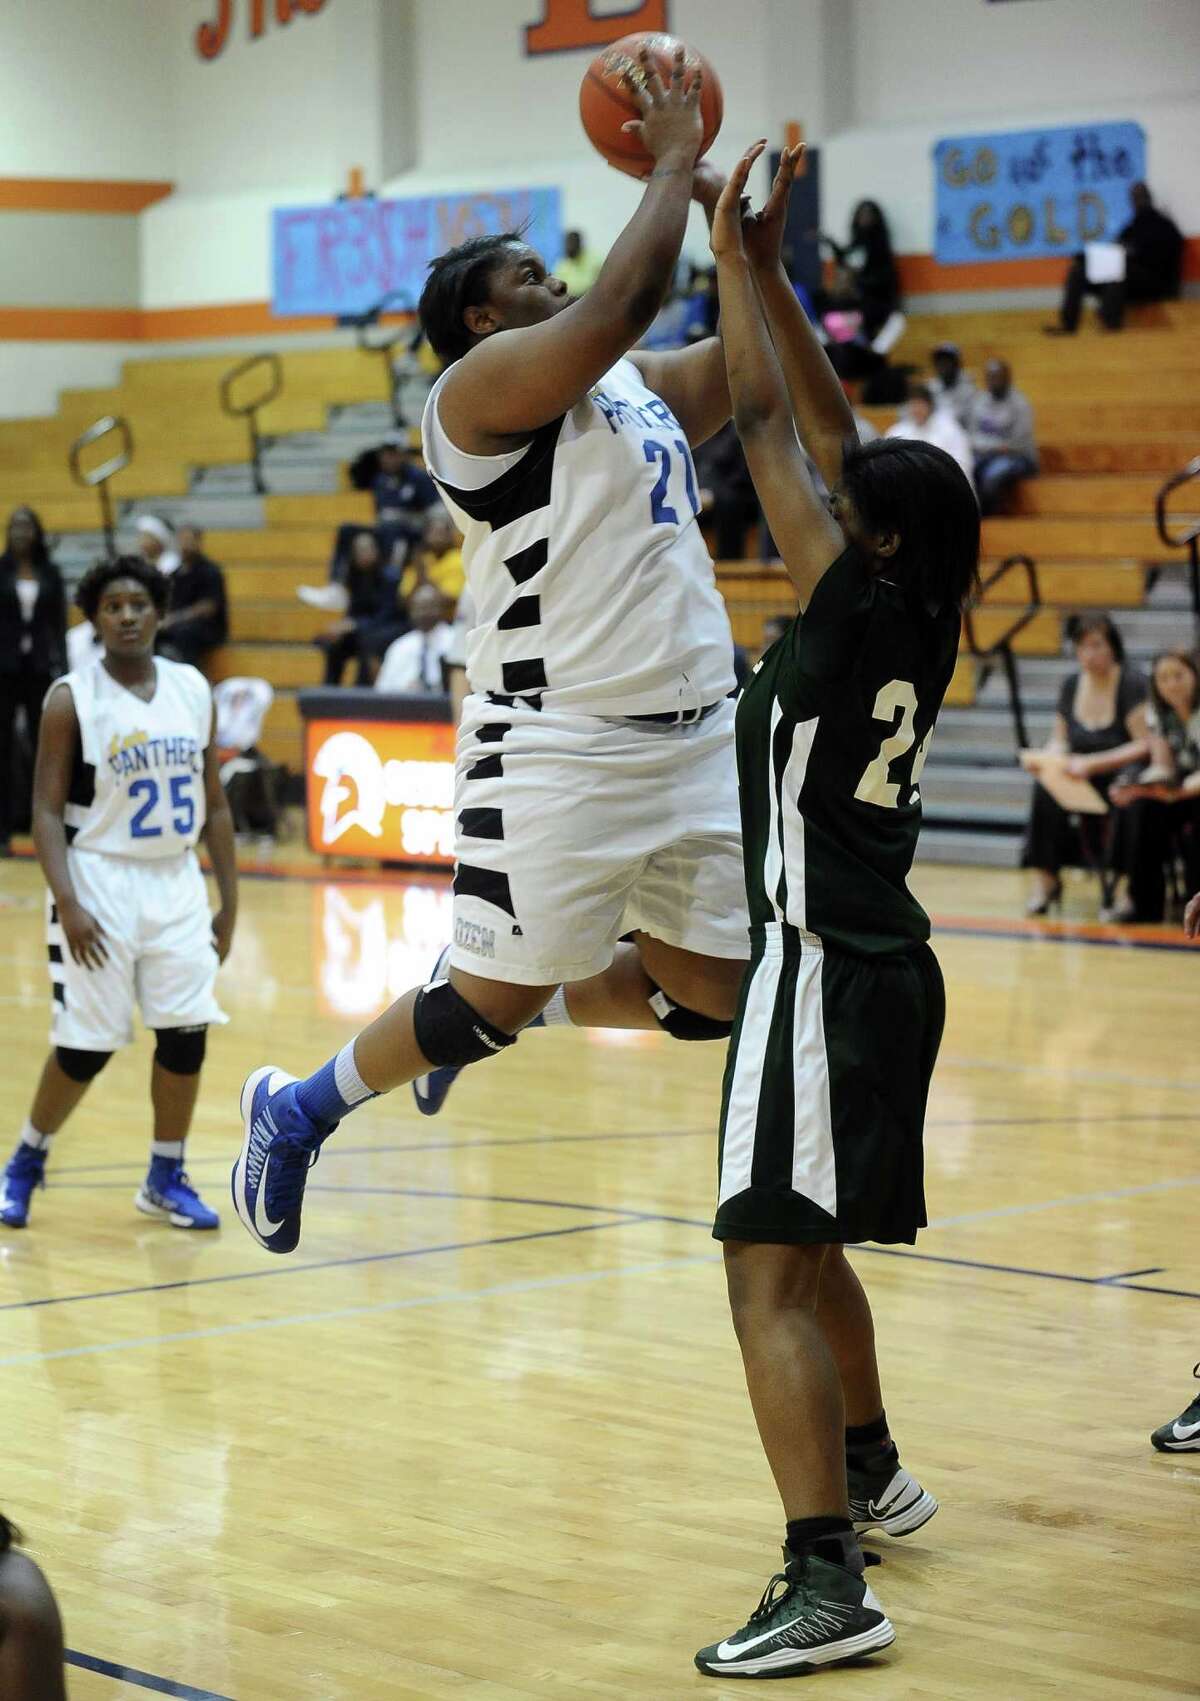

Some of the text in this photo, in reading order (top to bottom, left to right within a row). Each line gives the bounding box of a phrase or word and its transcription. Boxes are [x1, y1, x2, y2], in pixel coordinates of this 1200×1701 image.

[944, 147, 997, 187] GO
[968, 193, 1107, 250] GOLD
[643, 439, 700, 524] 21
[128, 775, 195, 838] 25
